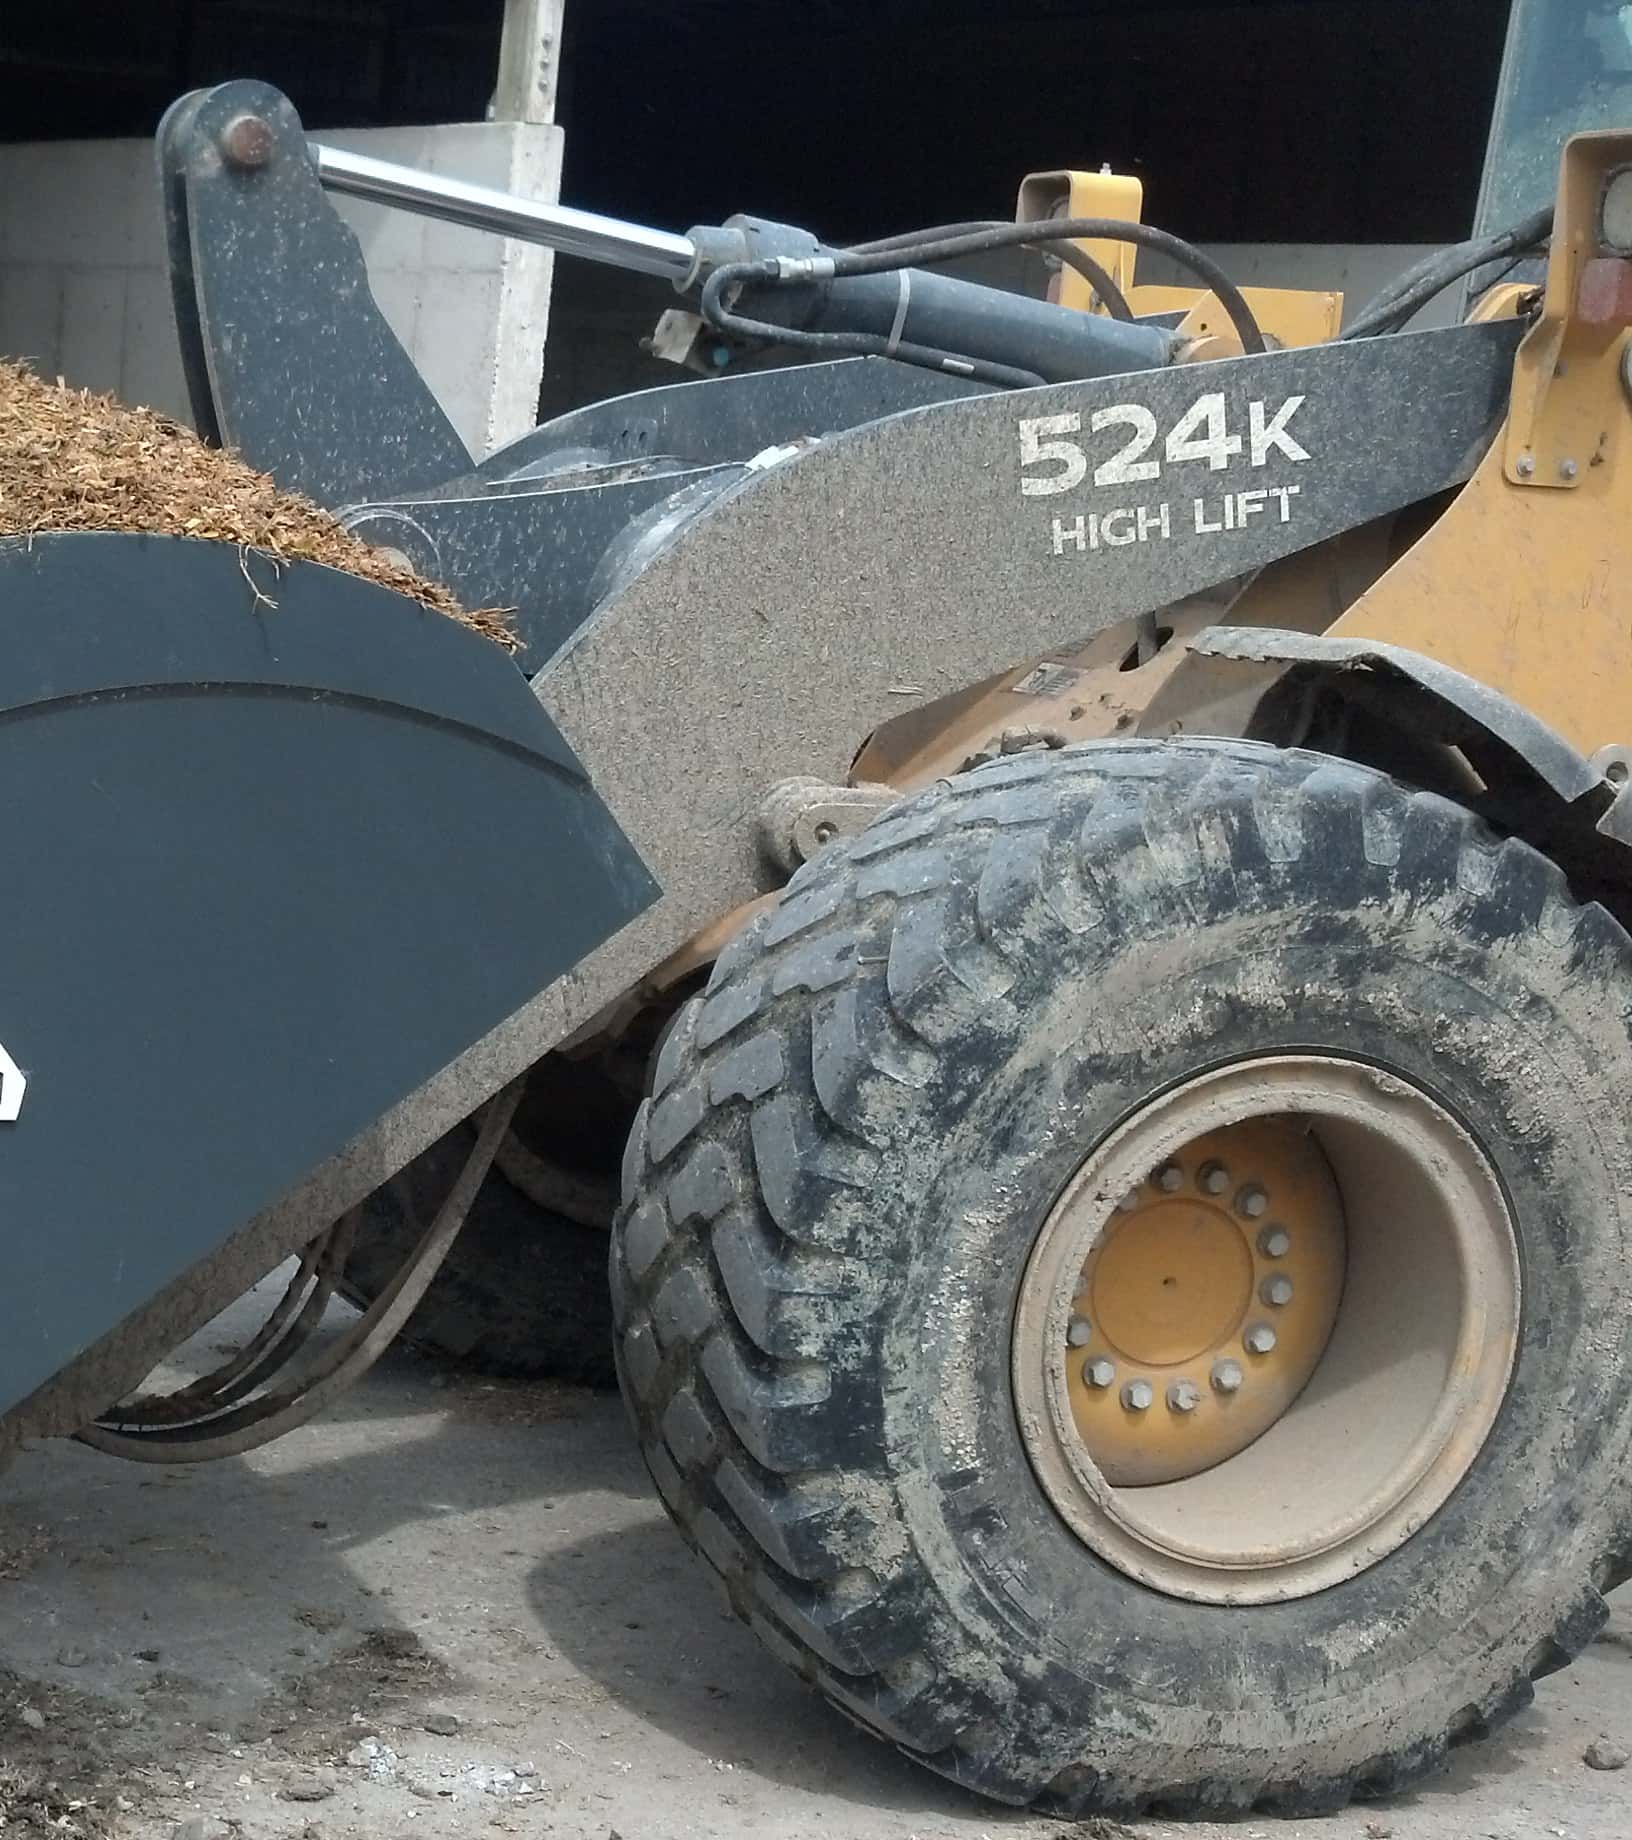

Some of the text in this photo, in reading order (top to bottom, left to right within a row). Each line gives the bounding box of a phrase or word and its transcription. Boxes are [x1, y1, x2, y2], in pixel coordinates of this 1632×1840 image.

[1018, 391, 1312, 496] 524K
[1051, 484, 1300, 556] HIGH LIFT
